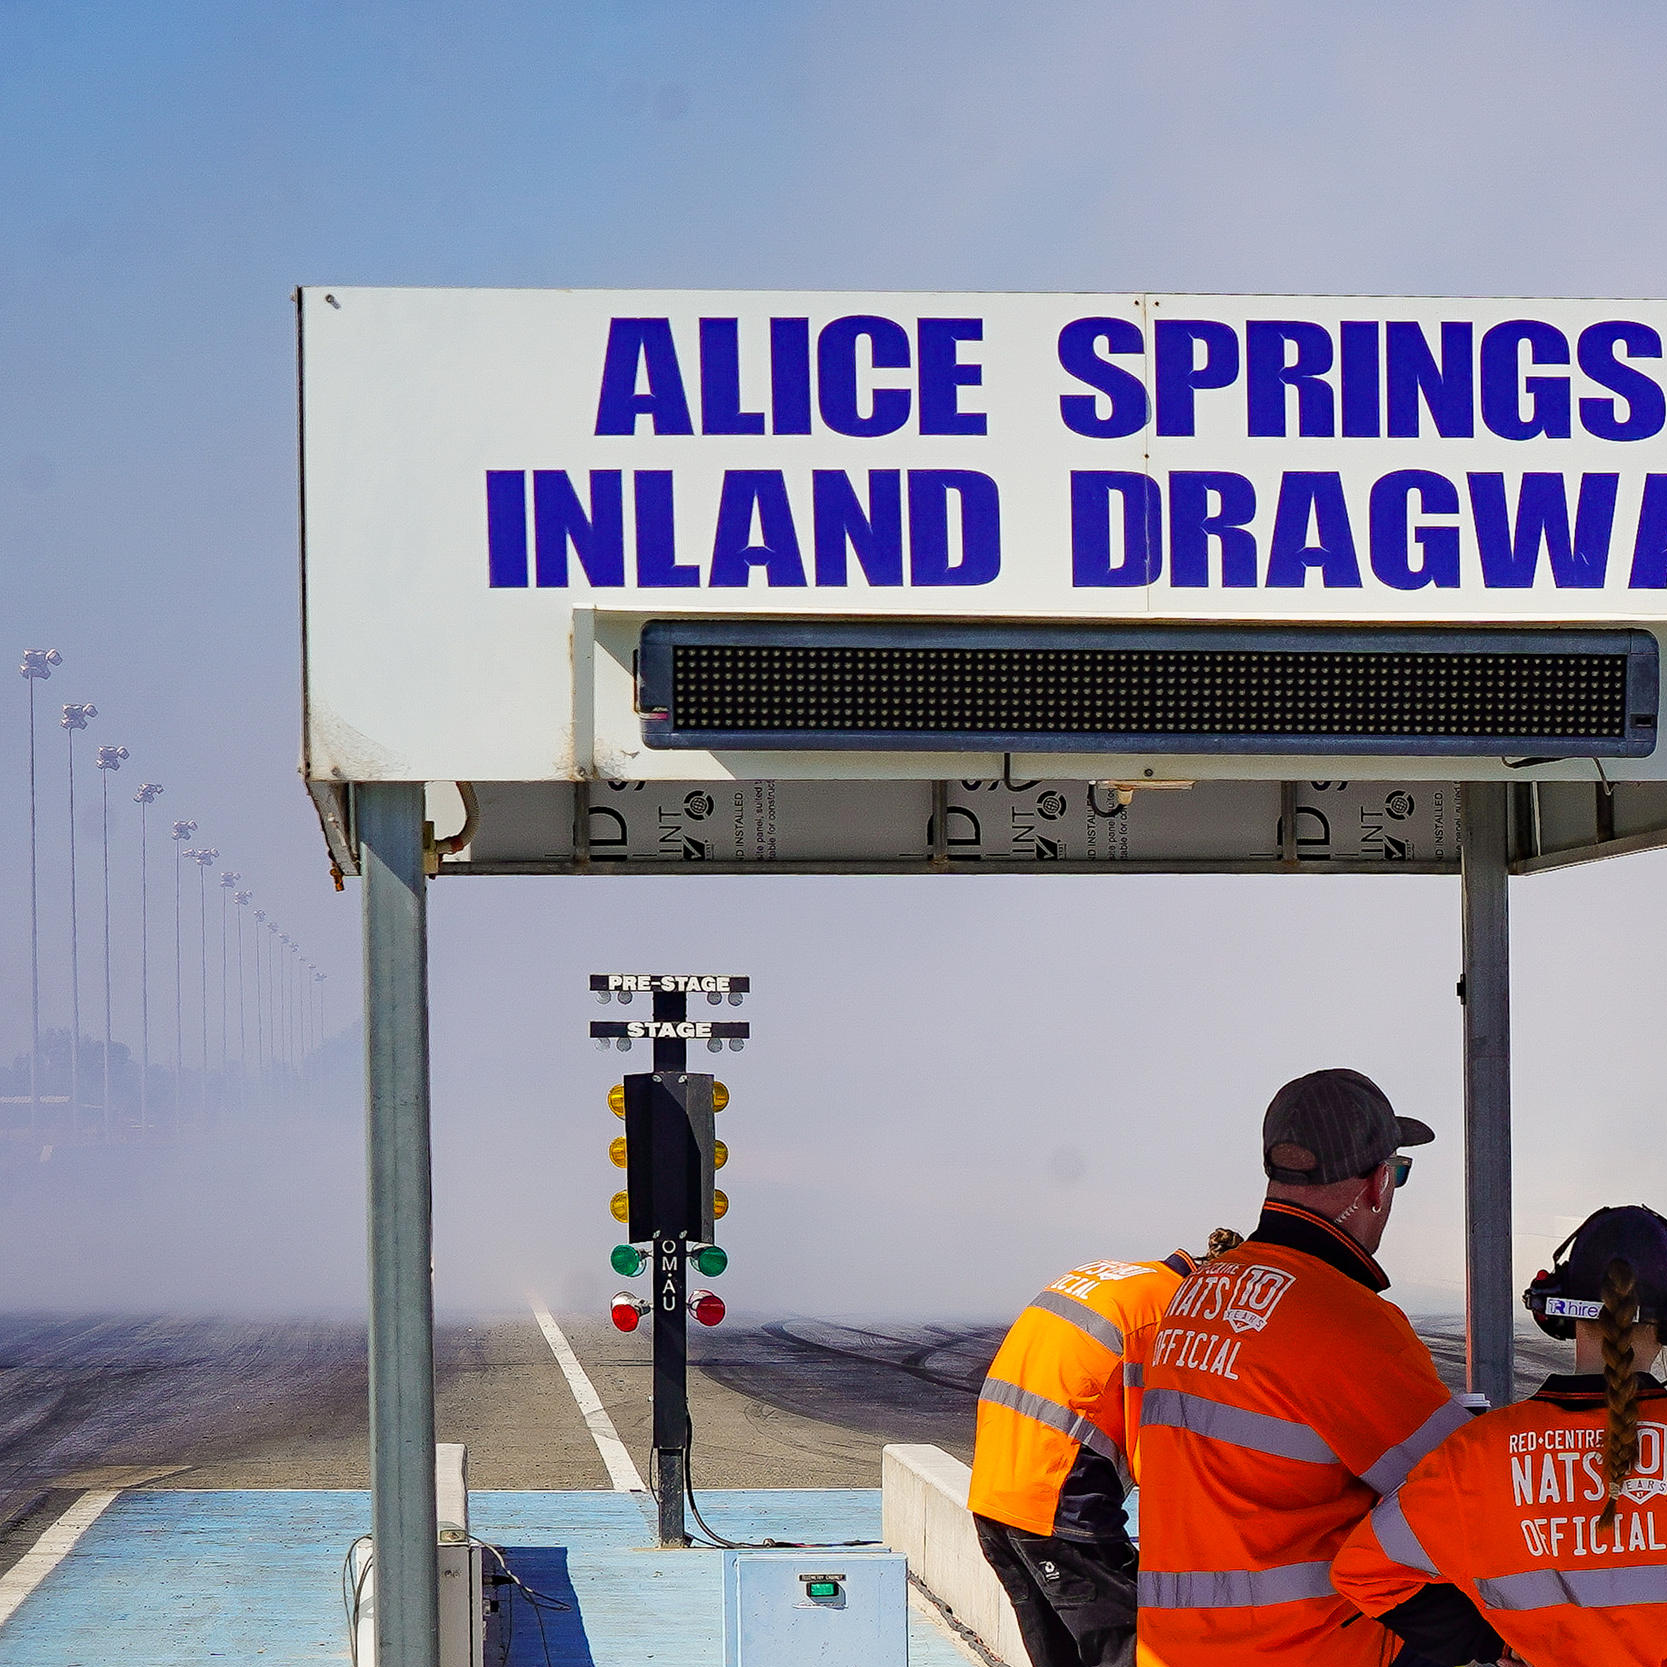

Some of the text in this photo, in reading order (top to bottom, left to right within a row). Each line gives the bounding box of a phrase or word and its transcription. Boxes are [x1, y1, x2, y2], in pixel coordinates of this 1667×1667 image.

[596, 316, 1665, 441] ALICE SPRINGS
[487, 470, 1000, 587] INLAND
[607, 975, 731, 992] PRE-STAGE
[627, 1022, 712, 1038] STAGE
[1238, 1269, 1285, 1310] 10
[1568, 1301, 1599, 1318] hire
[1152, 1328, 1242, 1381] OFFICIAL
[1509, 1429, 1605, 1454] RED CENTRE
[1511, 1453, 1605, 1507] NATS
